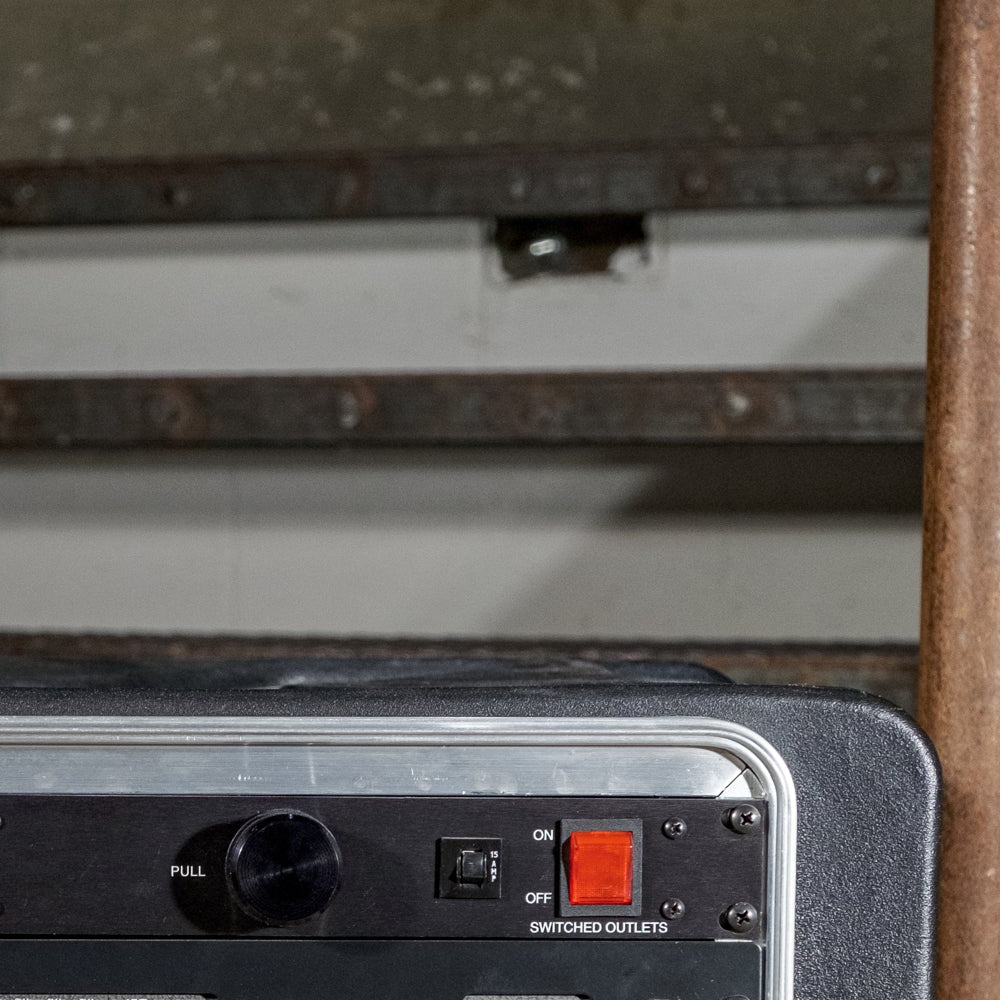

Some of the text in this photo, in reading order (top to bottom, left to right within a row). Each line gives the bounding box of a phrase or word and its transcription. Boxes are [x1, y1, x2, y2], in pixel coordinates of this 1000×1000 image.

[532, 828, 554, 841] ON
[490, 850, 499, 859] 15
[170, 865, 206, 877] PULL
[525, 892, 553, 905] OFF
[529, 921, 668, 934] SWITCHED OUTLETS
